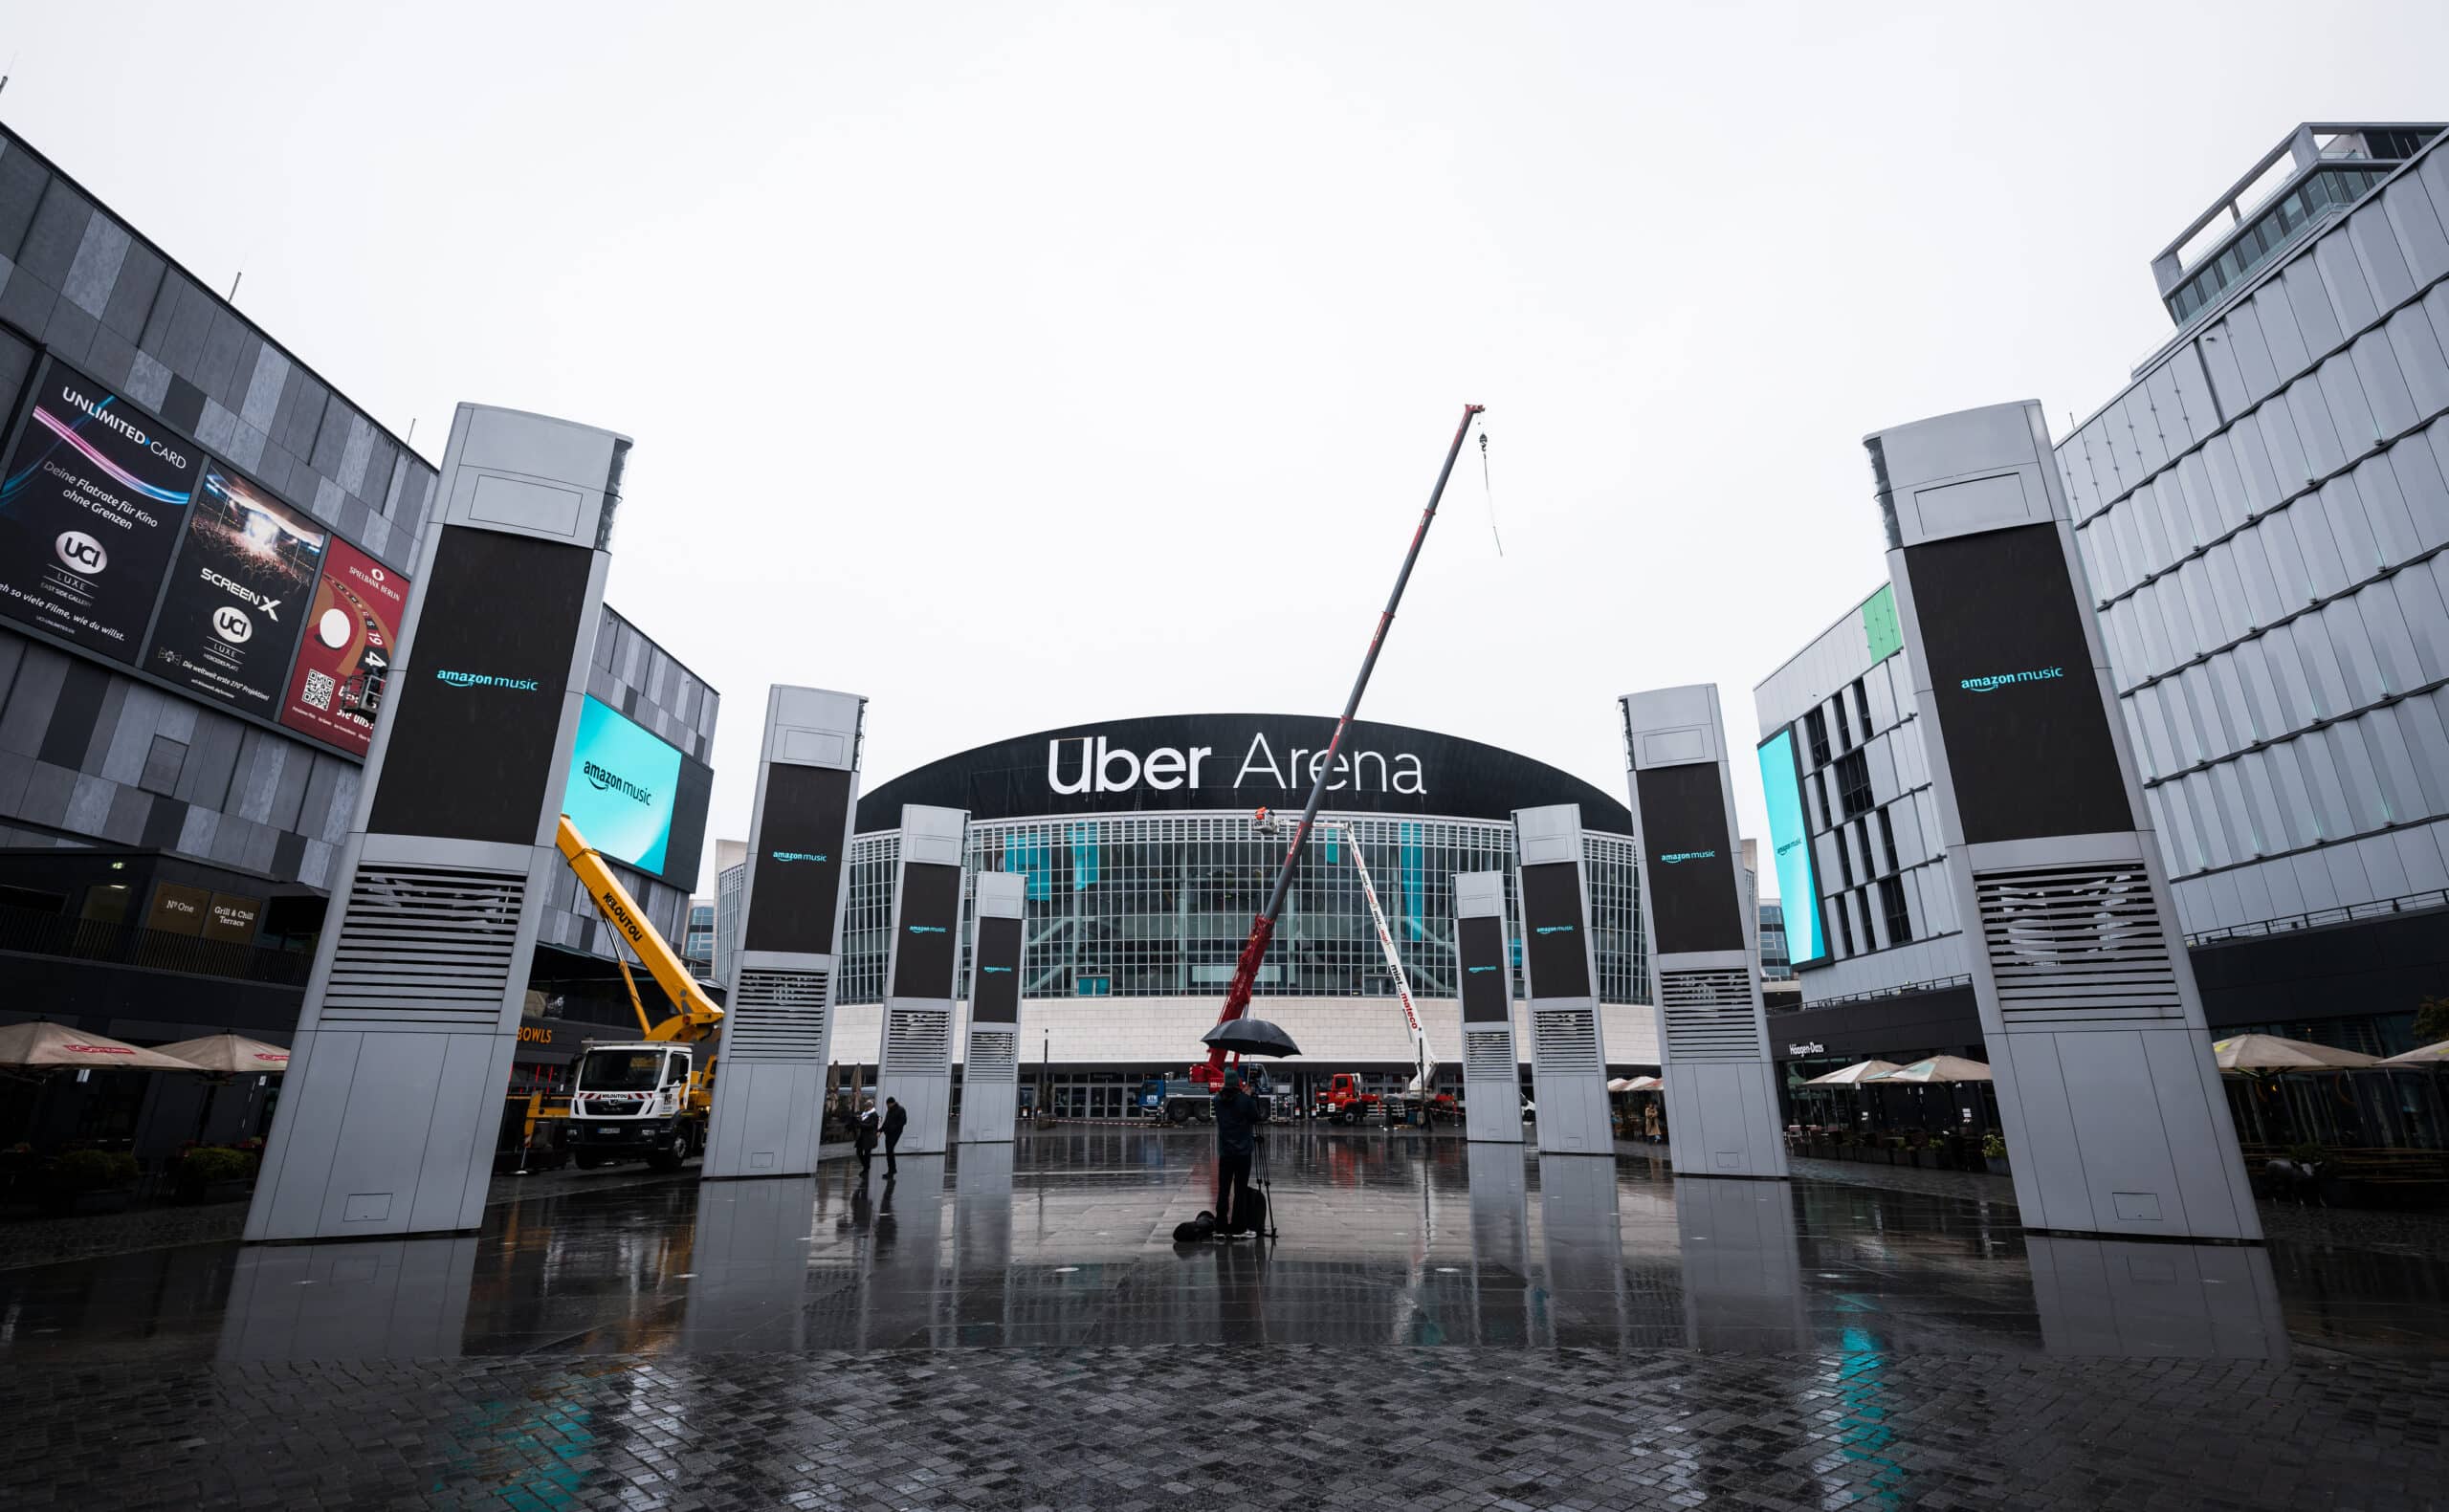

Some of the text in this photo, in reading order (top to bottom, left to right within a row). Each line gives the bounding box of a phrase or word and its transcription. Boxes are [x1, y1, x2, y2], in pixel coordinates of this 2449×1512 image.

[62, 386, 187, 469] UNLIMITED CARD
[43, 461, 158, 527] Deine Flatrate für Kino
[63, 489, 132, 529] ohne Grenzen
[64, 537, 100, 568] UCI
[57, 573, 87, 591] LUXE
[348, 566, 380, 589] SPIELBANK
[381, 585, 400, 601] BERLIN
[68, 594, 93, 607] GALLERY
[10, 588, 21, 598] so
[23, 594, 45, 607] viele
[45, 603, 71, 619] Filme,
[73, 614, 88, 625] wie
[89, 621, 100, 630] du
[101, 625, 125, 641] willst.
[219, 612, 247, 637] UCI
[214, 643, 235, 658] LUXE
[368, 632, 383, 646] 19
[364, 650, 386, 667] 4
[183, 660, 193, 669] Die
[192, 665, 217, 679] weltweit
[217, 672, 230, 685] erste
[437, 669, 539, 690] amazon music
[1961, 666, 2063, 691] amazon music
[1048, 733, 1427, 795] Uber Arena
[584, 760, 651, 806] amazon music
[773, 851, 827, 862] amazon music
[1661, 849, 1715, 864] amazon music
[178, 902, 194, 913] One
[214, 906, 231, 916] Grill
[237, 910, 254, 920] Chill
[219, 915, 245, 927] Terrace
